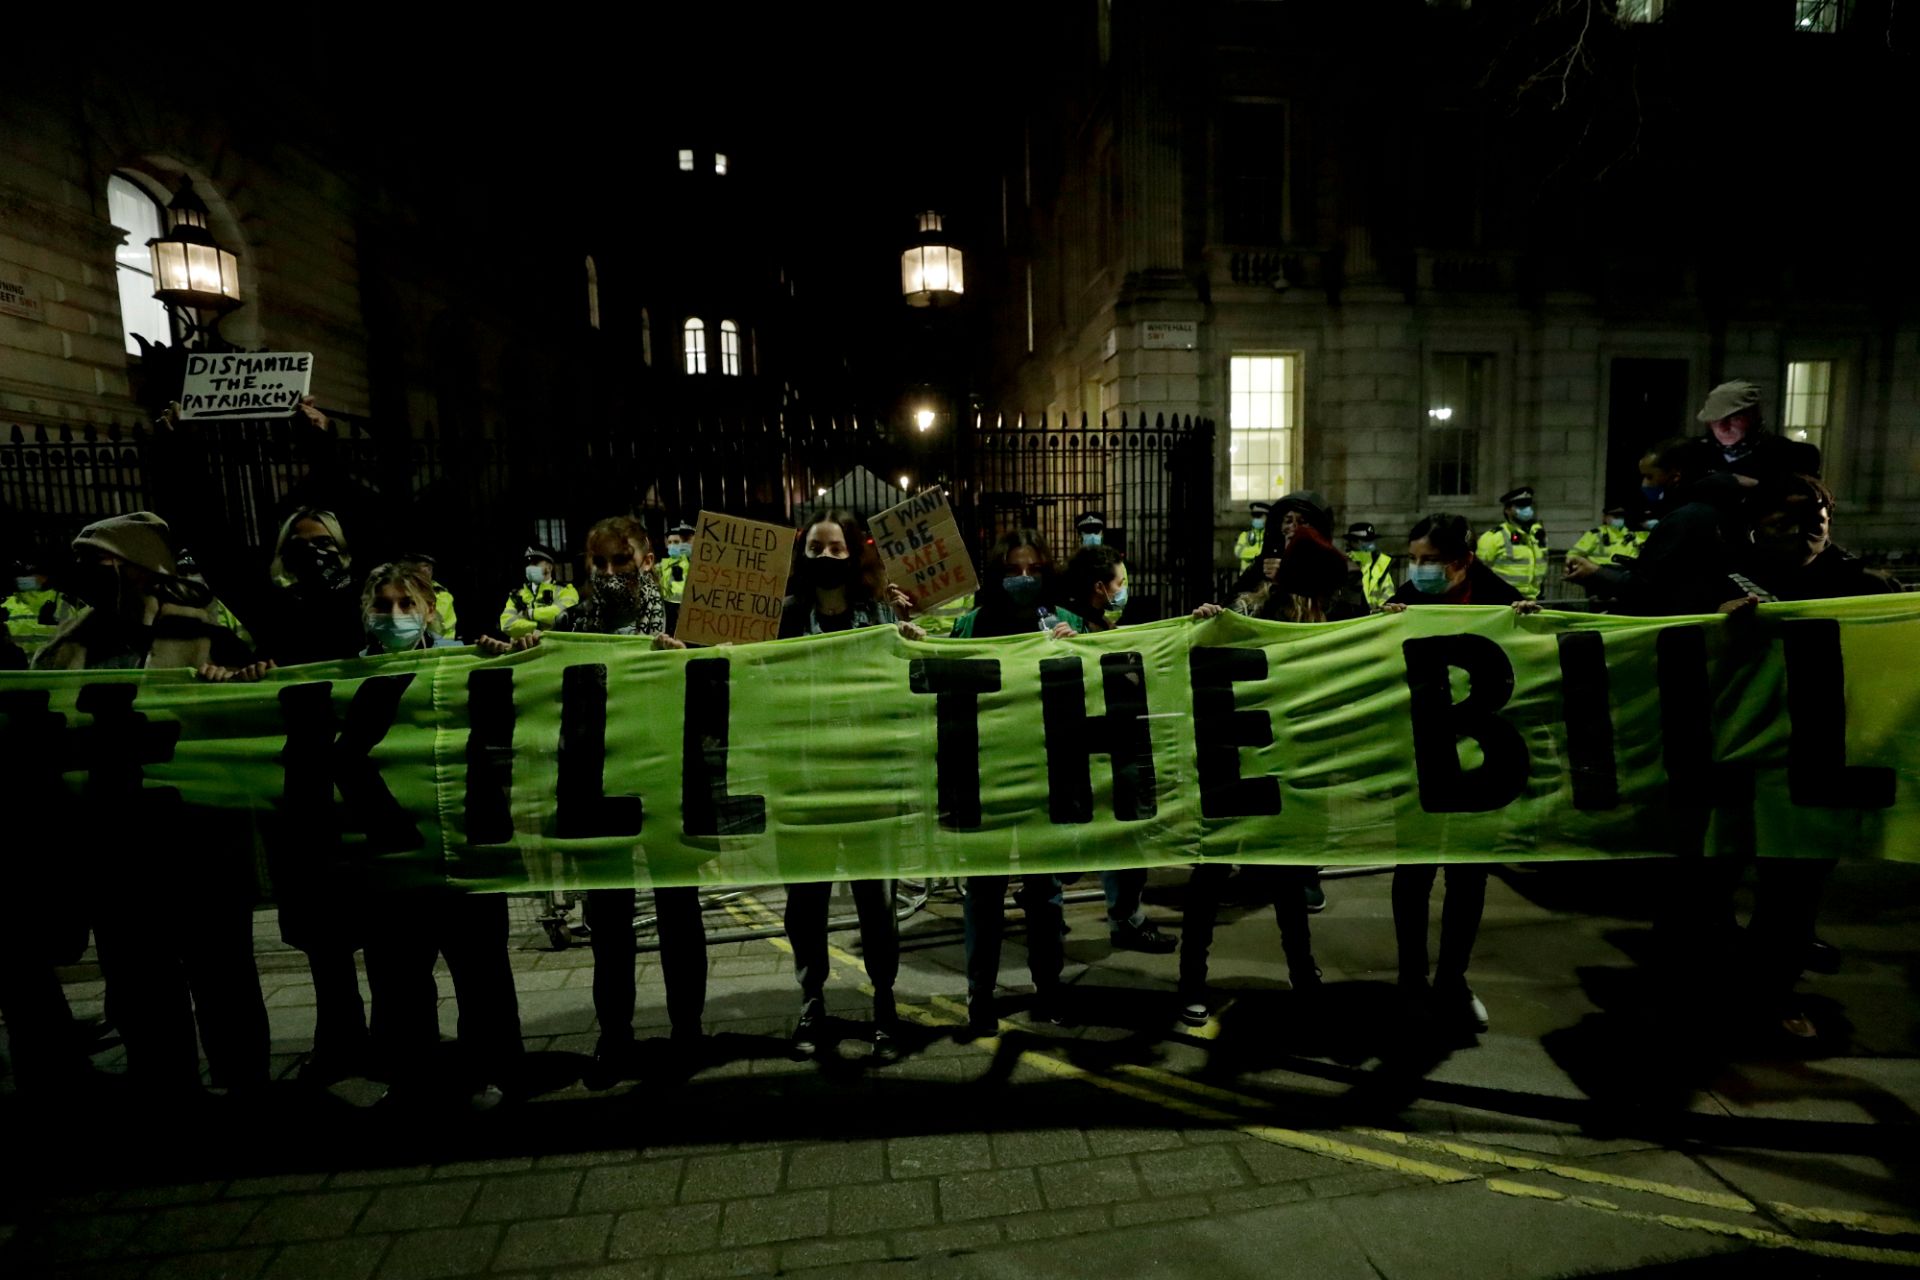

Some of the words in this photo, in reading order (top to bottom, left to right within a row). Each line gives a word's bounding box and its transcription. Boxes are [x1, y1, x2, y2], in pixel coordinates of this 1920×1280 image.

[1147, 323, 1192, 332] WHITEHALL
[188, 355, 309, 375] DISMANTLE
[183, 390, 300, 411] PATRIARCHY
[874, 515, 894, 541] I
[895, 489, 944, 527] WANT
[702, 518, 777, 551] KILLED
[906, 520, 934, 550] BE
[700, 542, 726, 563] BY
[734, 548, 768, 572] THE
[902, 538, 949, 573] SAFE
[695, 564, 778, 596] SYSTEM
[914, 561, 947, 584] NOT
[692, 584, 745, 611] WE'RE
[750, 593, 783, 619] TOLD
[687, 608, 779, 641] PROTECTS
[909, 646, 1282, 828] THE
[1402, 618, 1896, 814] BILL
